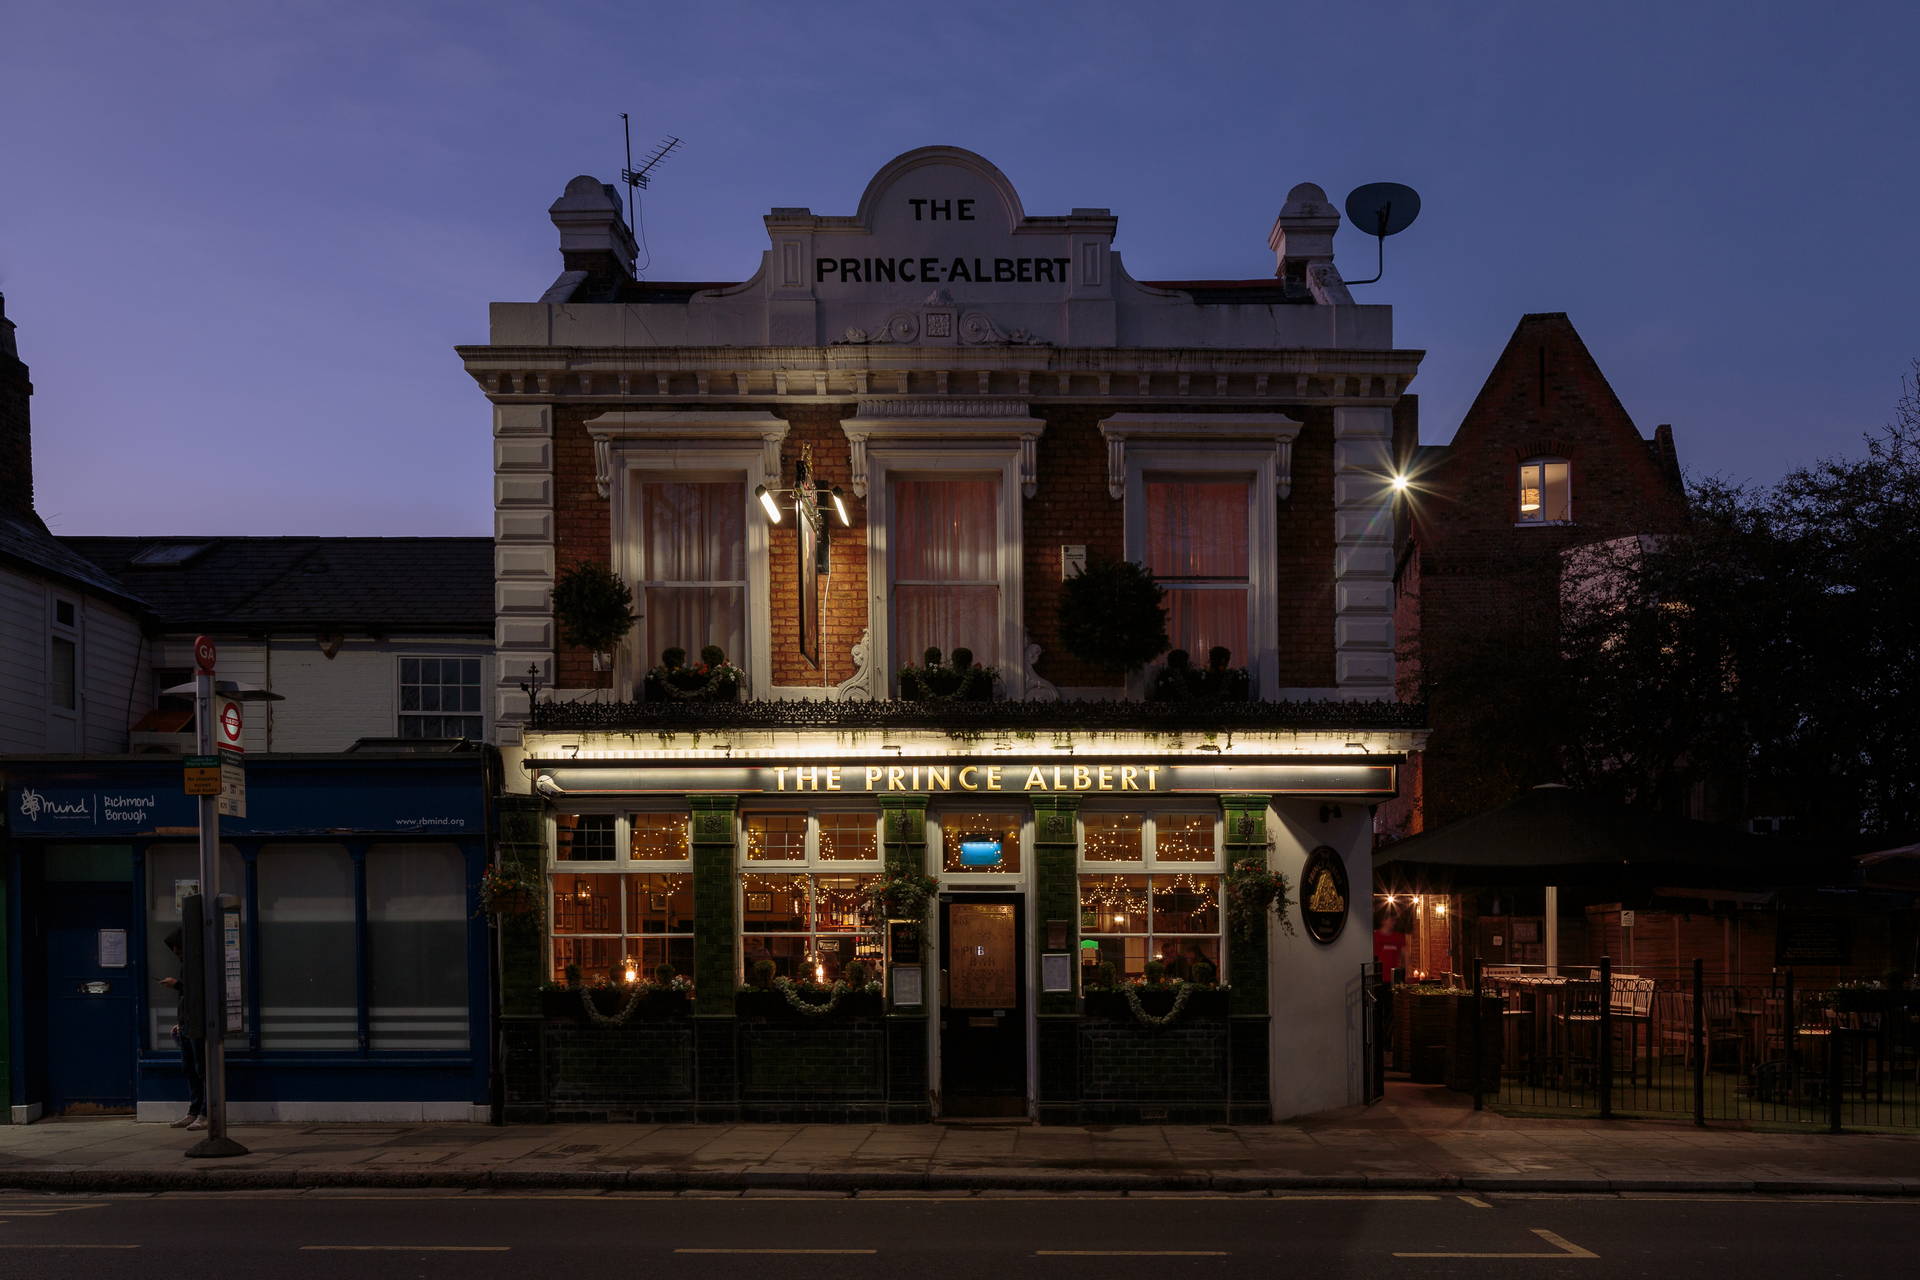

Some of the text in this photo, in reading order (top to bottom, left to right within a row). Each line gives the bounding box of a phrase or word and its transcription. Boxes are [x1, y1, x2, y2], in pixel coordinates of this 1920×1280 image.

[908, 199, 976, 221] THE
[815, 257, 1072, 284] PRINCE-ALBERT
[199, 644, 215, 661] GA
[773, 765, 1161, 792] THE PRINCE ALBERT
[103, 795, 155, 808] Richmond
[104, 808, 147, 825] Borough
